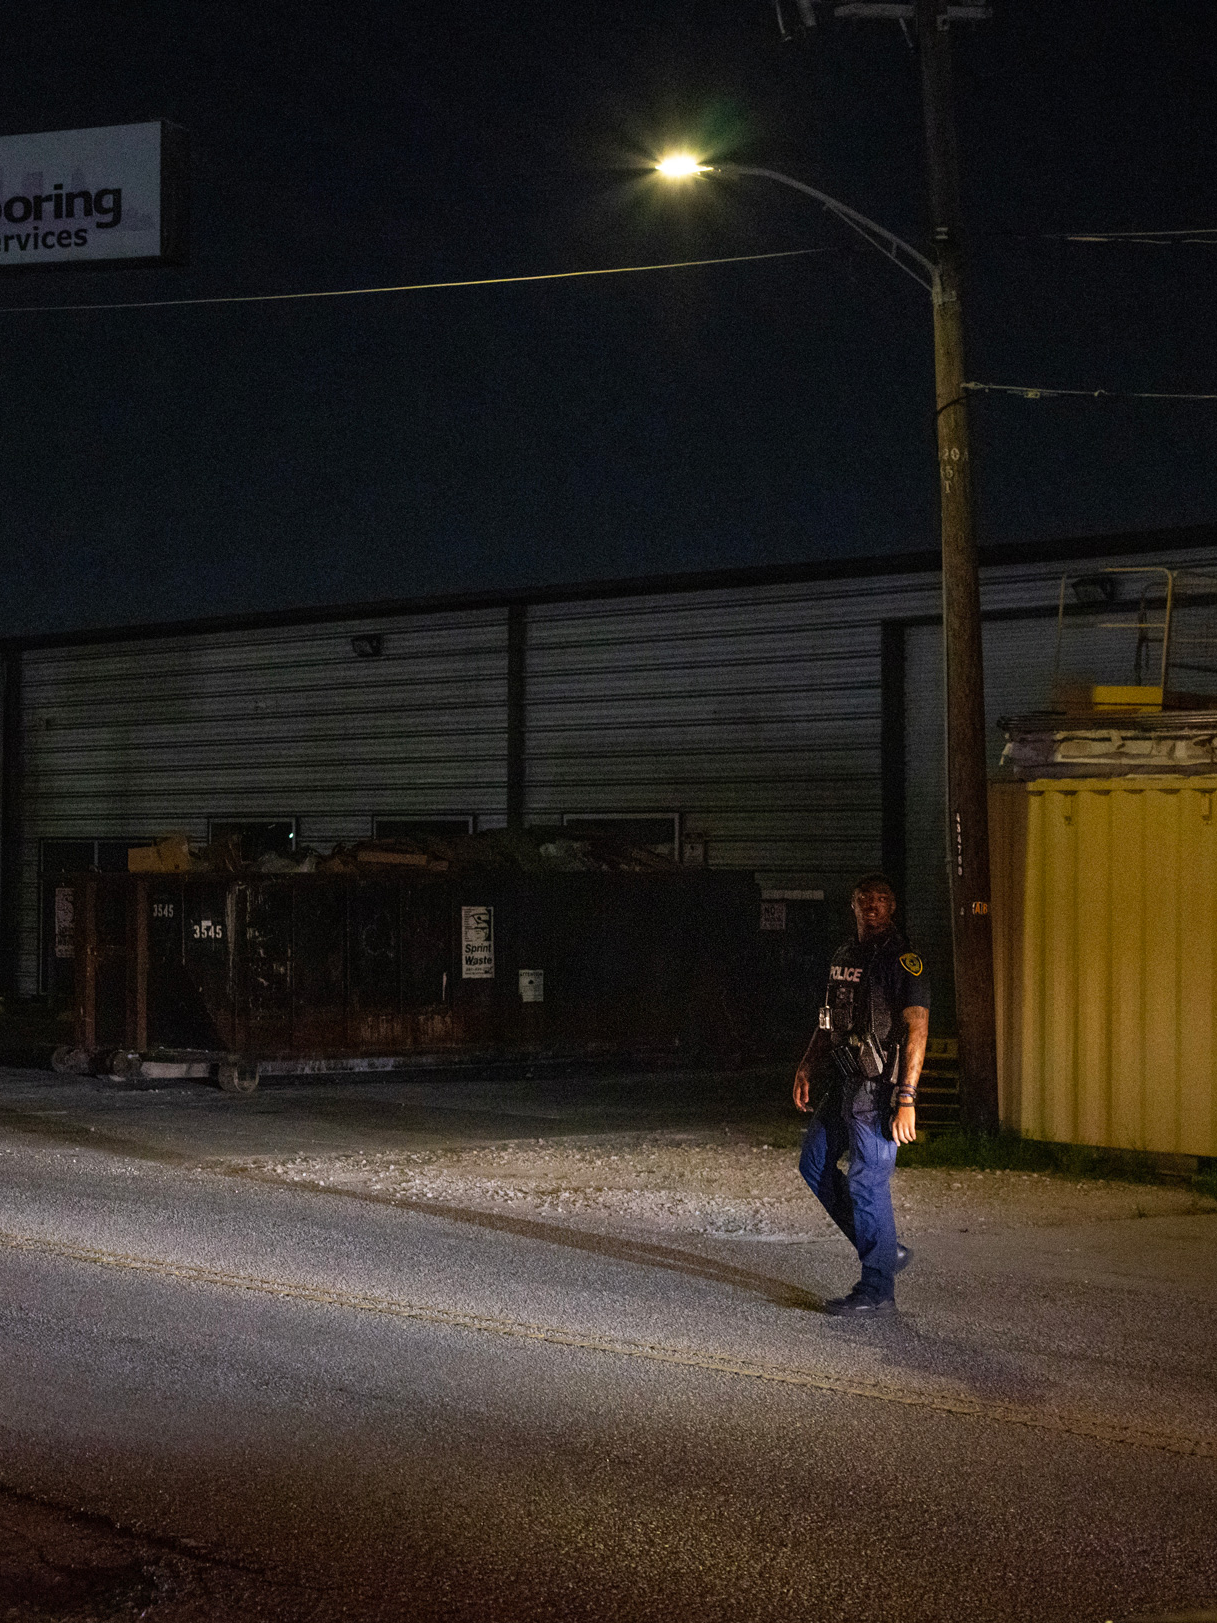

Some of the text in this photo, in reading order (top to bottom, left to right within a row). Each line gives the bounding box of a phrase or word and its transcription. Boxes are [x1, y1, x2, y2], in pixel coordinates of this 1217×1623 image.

[153, 903, 174, 918] 3545
[193, 924, 222, 939] 3545
[465, 943, 491, 954] Sprint
[465, 956, 492, 965] Waste
[829, 965, 863, 982] POLICE
